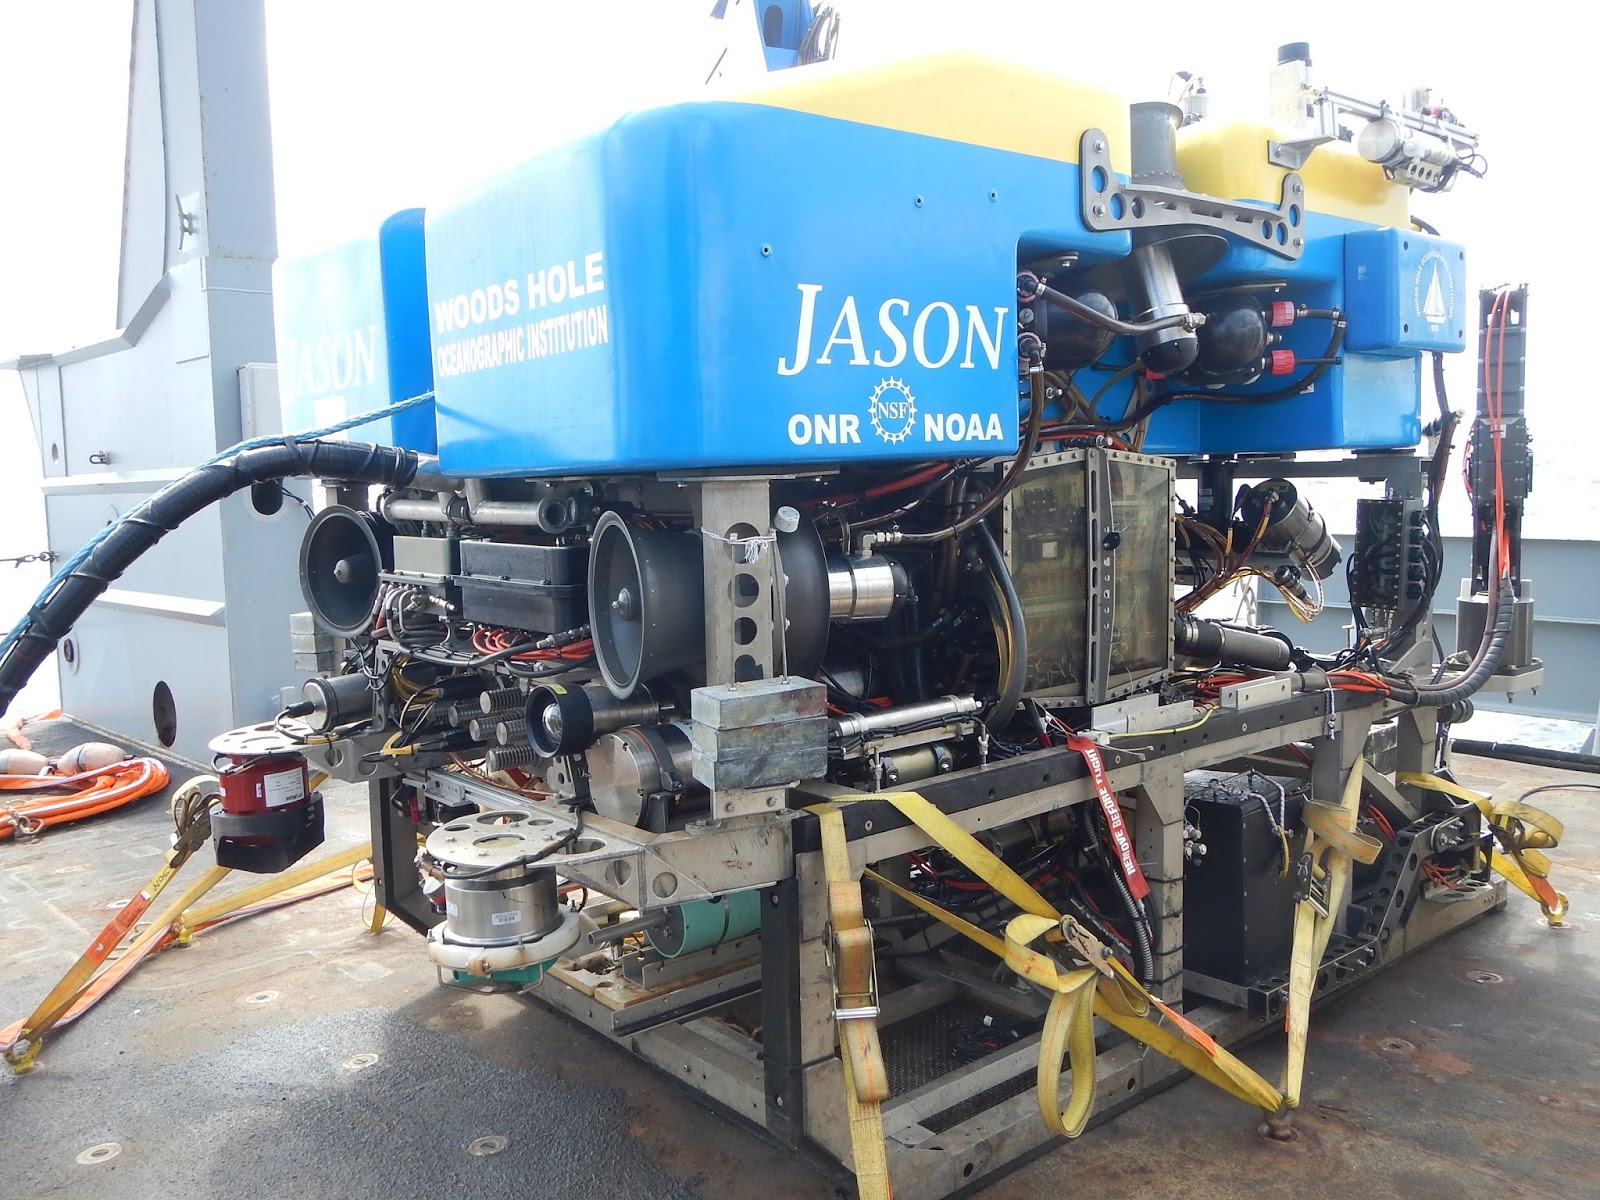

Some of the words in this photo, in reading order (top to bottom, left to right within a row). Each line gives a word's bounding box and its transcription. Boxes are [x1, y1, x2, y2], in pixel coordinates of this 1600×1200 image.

[434, 279, 520, 334] WOODS
[527, 251, 604, 310] HOLE
[437, 326, 525, 378] OCEANOGRAPHIC
[527, 304, 609, 360] INSTITUTION
[777, 283, 1009, 376] JASON
[281, 324, 377, 405] JASON
[787, 413, 862, 446] ONR
[876, 401, 909, 420] NSF
[923, 413, 1004, 442] NOAA
[1085, 749, 1103, 785] FLIGHT
[1098, 786, 1122, 829] BEFORE
[1114, 829, 1137, 876] REMOVE
